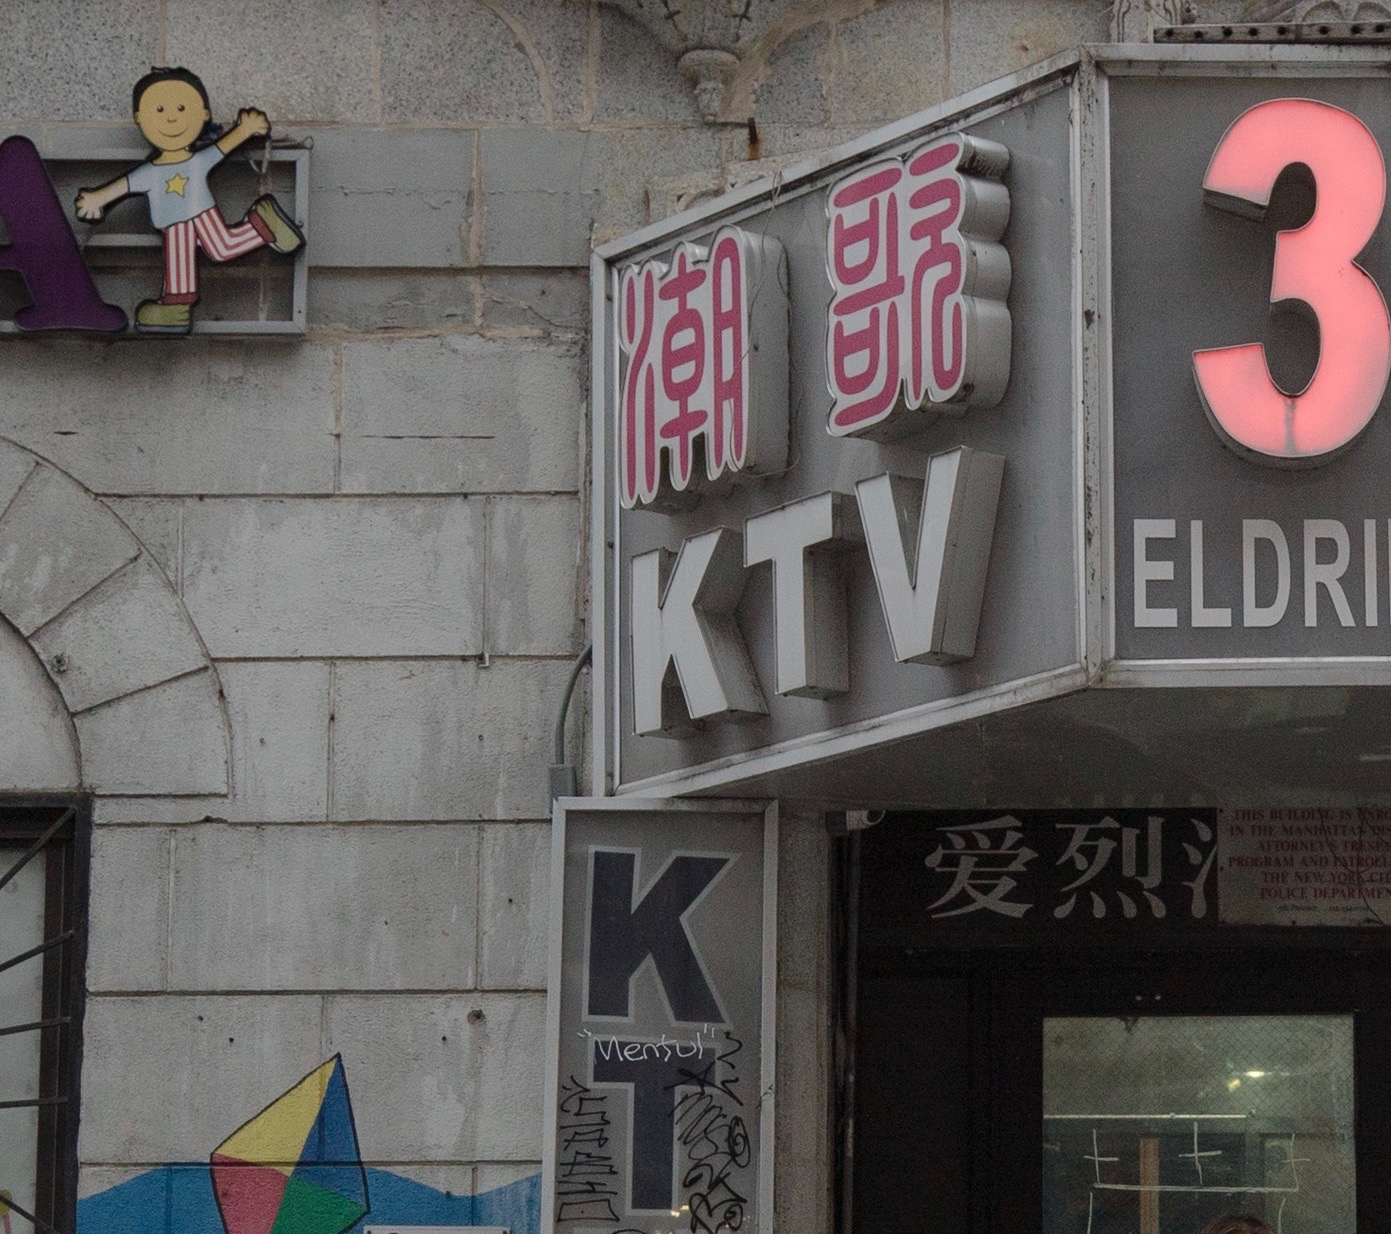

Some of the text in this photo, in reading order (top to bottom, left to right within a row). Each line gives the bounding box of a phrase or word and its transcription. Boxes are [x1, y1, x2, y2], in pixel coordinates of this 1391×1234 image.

[621, 131, 966, 509] 潮歌
[631, 445, 972, 738] KTV
[1234, 808, 1264, 821] THIS
[1270, 808, 1335, 821] BUILDING
[1340, 808, 1351, 821] IS
[1229, 824, 1243, 836] IN
[1250, 824, 1276, 836] THE
[1282, 825, 1366, 837] MANHATTAN
[923, 815, 1217, 919] 爱烈
[1228, 856, 1294, 868] PROGRAM
[1301, 856, 1328, 868] AND
[1262, 872, 1289, 884] THE
[1295, 872, 1325, 884] NEW
[1329, 872, 1362, 884] YORK
[1260, 887, 1308, 900] POLICE
